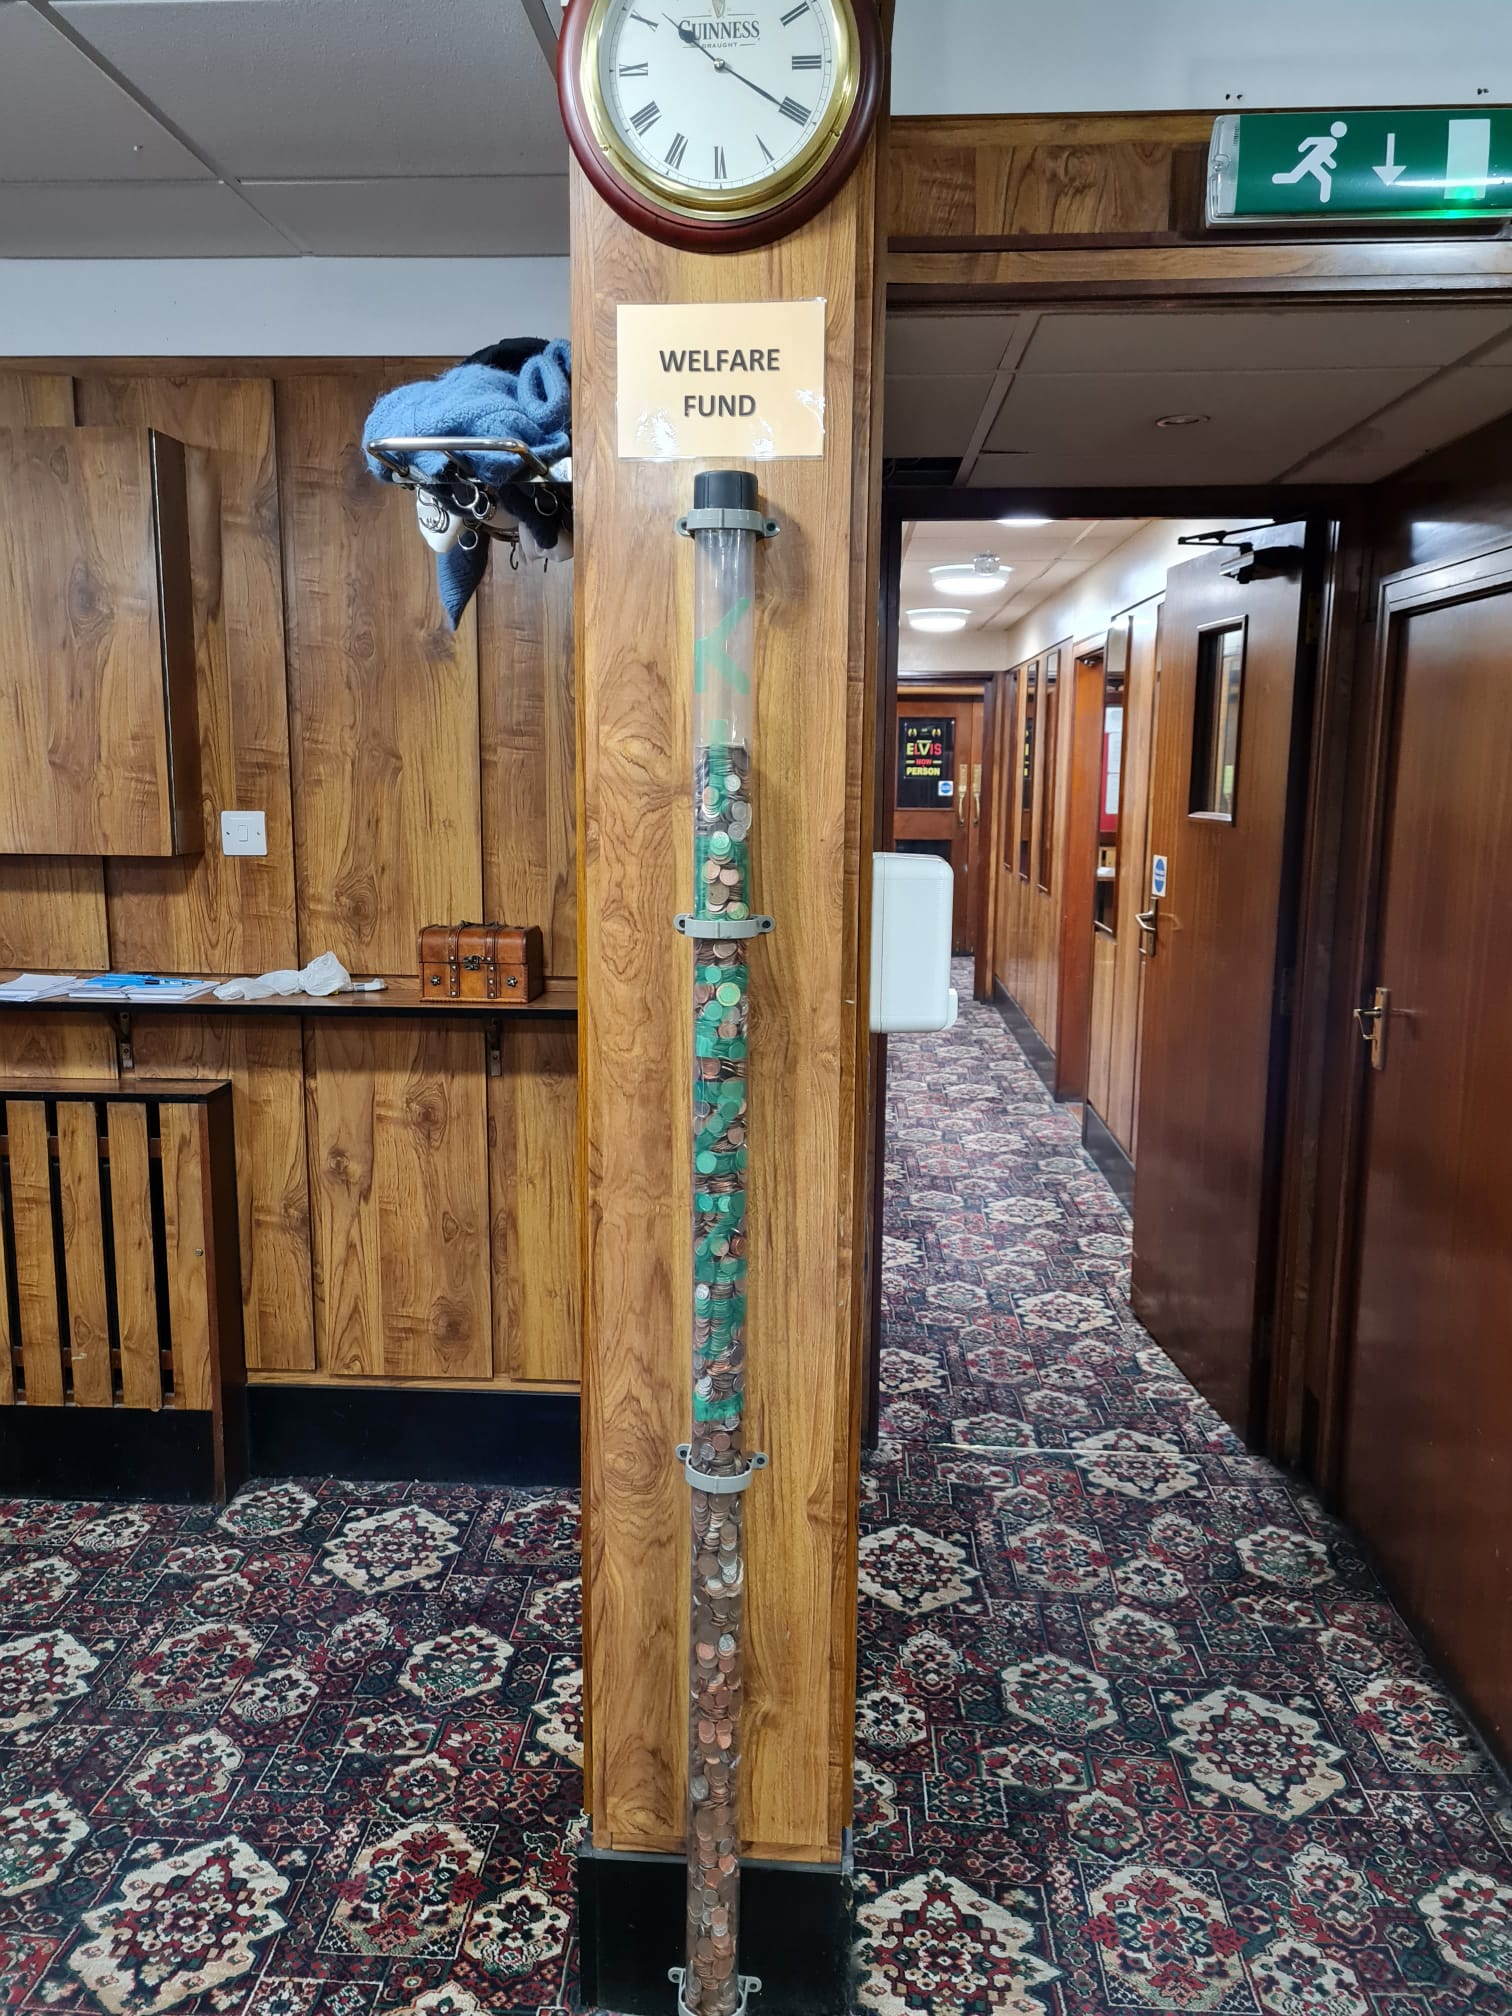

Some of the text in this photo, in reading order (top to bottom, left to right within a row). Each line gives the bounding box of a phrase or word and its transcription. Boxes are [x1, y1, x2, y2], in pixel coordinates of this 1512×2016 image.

[791, 54, 822, 70] III
[659, 348, 781, 373] WELFARE
[684, 395, 756, 417] FUND
[906, 740, 942, 756] ELVIS
[906, 767, 941, 776] PERSON
